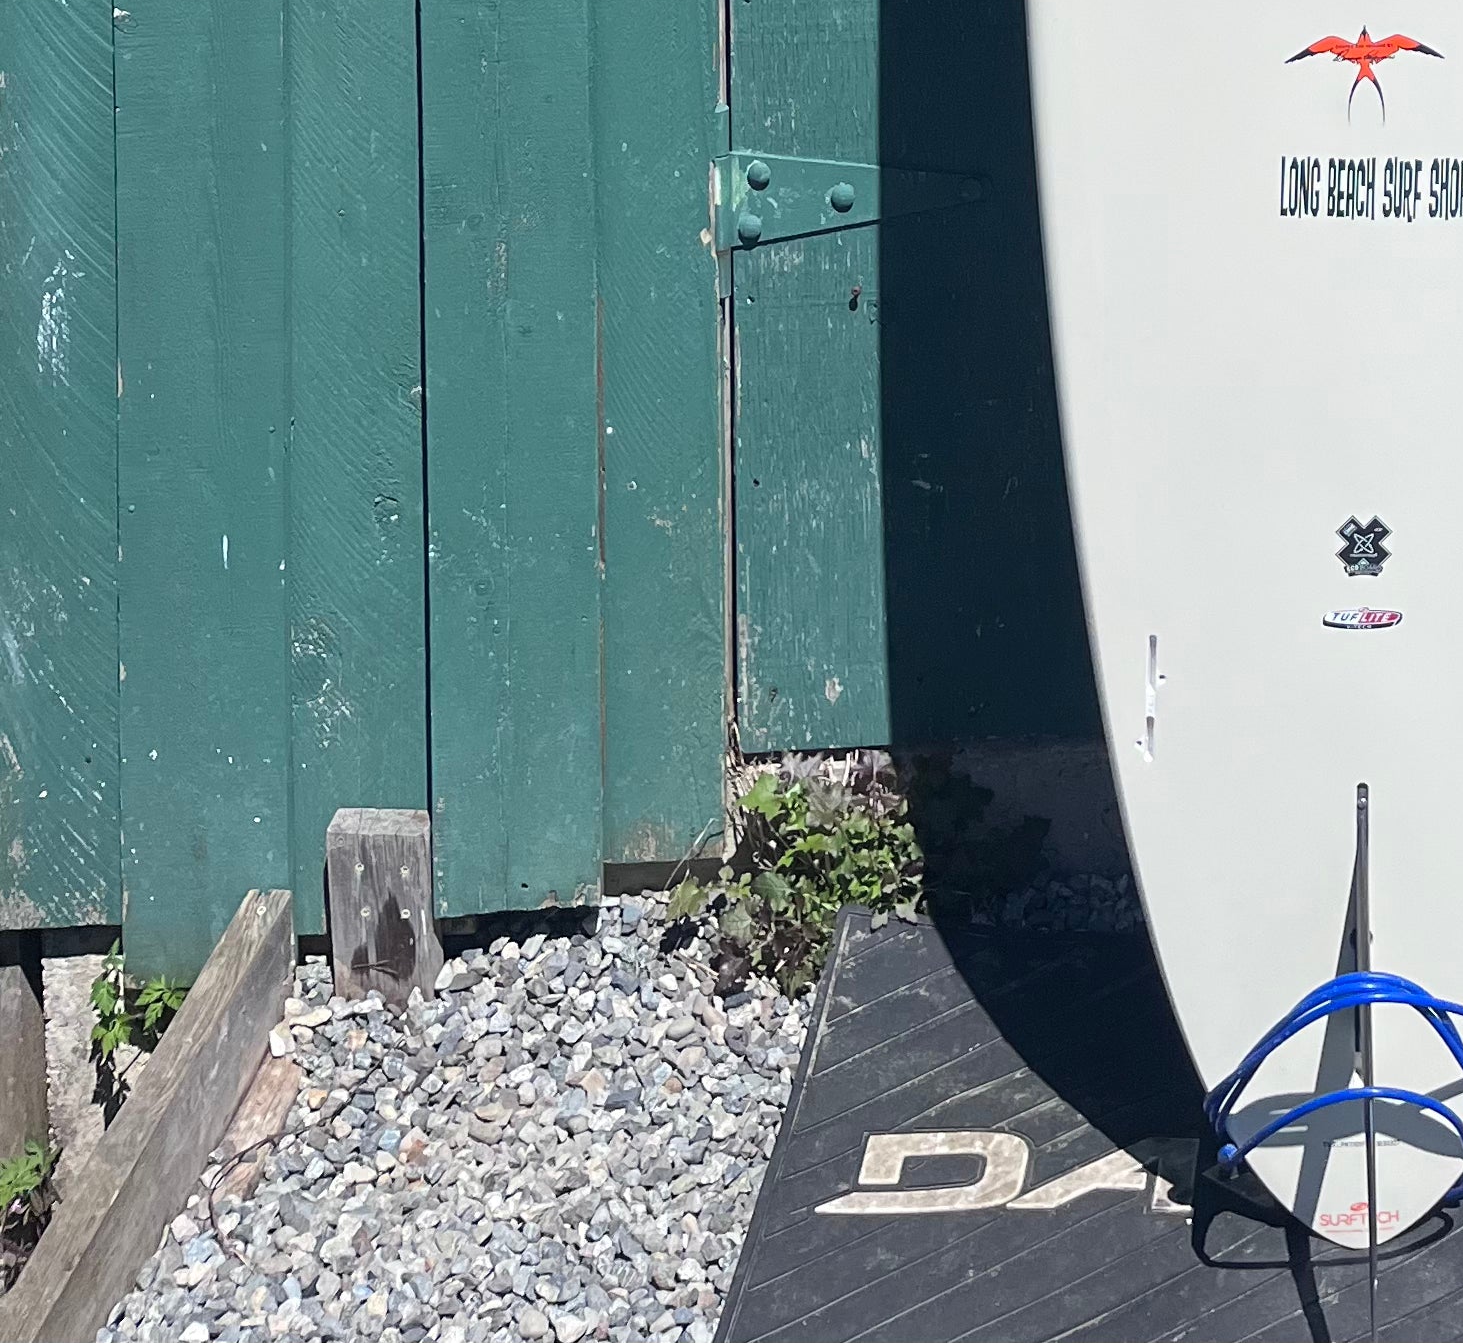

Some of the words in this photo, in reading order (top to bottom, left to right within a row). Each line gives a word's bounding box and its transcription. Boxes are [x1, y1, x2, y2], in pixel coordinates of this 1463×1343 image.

[1279, 156, 1321, 219] LONG
[1327, 156, 1377, 221] BEACH
[1382, 156, 1423, 223] SURF
[1319, 1209, 1400, 1227] SURFTCH
